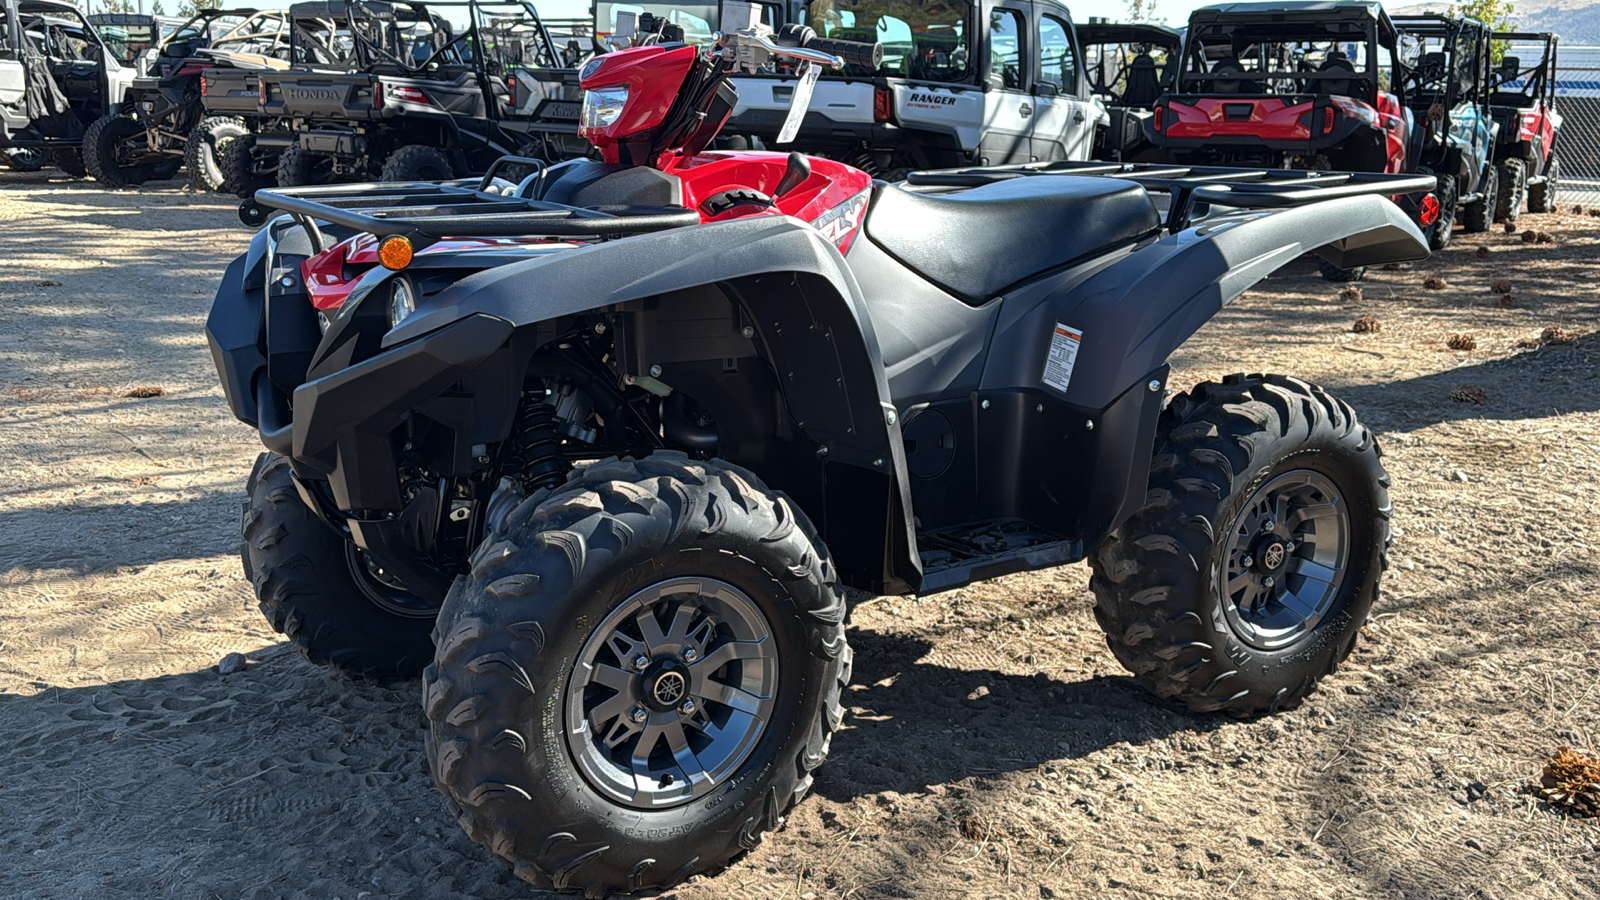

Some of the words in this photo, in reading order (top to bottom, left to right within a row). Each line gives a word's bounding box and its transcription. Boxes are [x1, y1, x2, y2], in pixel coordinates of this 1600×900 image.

[290, 89, 341, 100] HONDA
[909, 93, 957, 105] RANGER
[551, 104, 579, 117] Kawa
